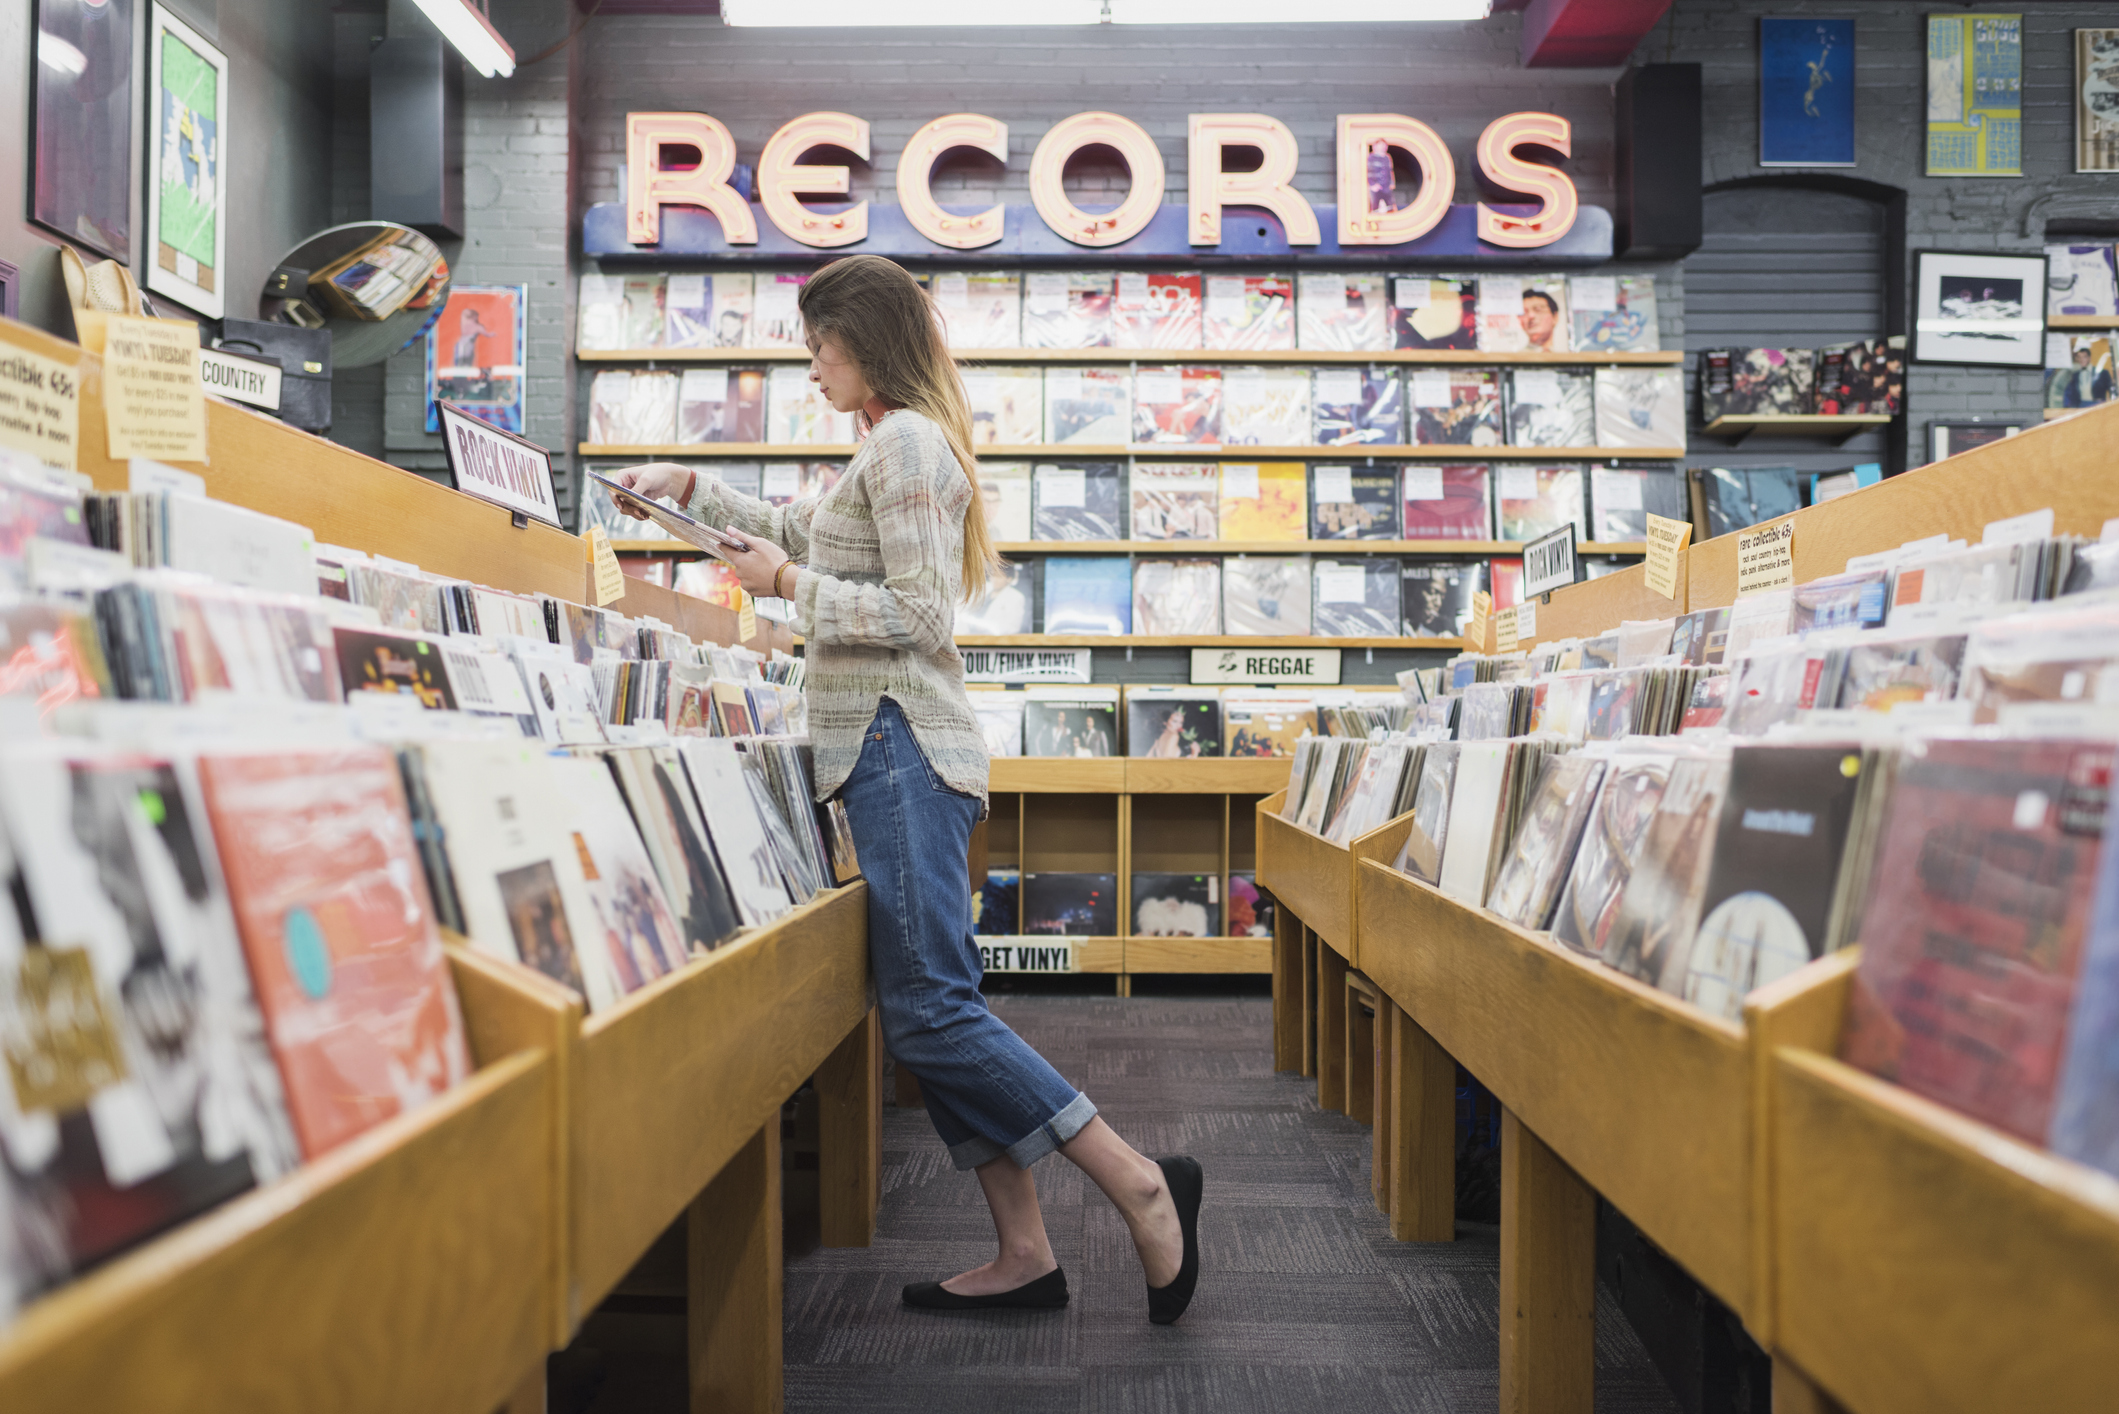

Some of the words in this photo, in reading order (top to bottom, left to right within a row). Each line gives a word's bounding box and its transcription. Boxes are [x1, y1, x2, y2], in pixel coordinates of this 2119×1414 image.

[626, 111, 1578, 248] RECORDS
[142, 325, 173, 342] Tuesday
[111, 339, 148, 360] VINYL
[149, 343, 193, 366] TUESDAY
[50, 370, 74, 399] 45s
[202, 360, 266, 394] COUNTRY
[37, 421, 43, 437] &
[455, 423, 507, 490] ROCK
[500, 443, 547, 505] VINYL
[1648, 525, 1659, 539] VINYL
[1659, 528, 1679, 544] TUESDAY
[1740, 538, 1751, 551] rare
[1753, 527, 1781, 547] collectible
[1781, 523, 1792, 539] 45s
[1530, 546, 1548, 583] ROCK
[1548, 537, 1569, 576] VINYL
[1748, 564, 1757, 576] punk
[1758, 560, 1777, 573] alternative
[1777, 558, 1781, 568] &
[1781, 558, 1790, 567] more
[1759, 550, 1772, 562] country
[1402, 567, 1430, 579] MILES
[1038, 652, 1077, 675] VINYL
[1246, 657, 1315, 675] REGGAE
[1017, 947, 1070, 971] VINYL
